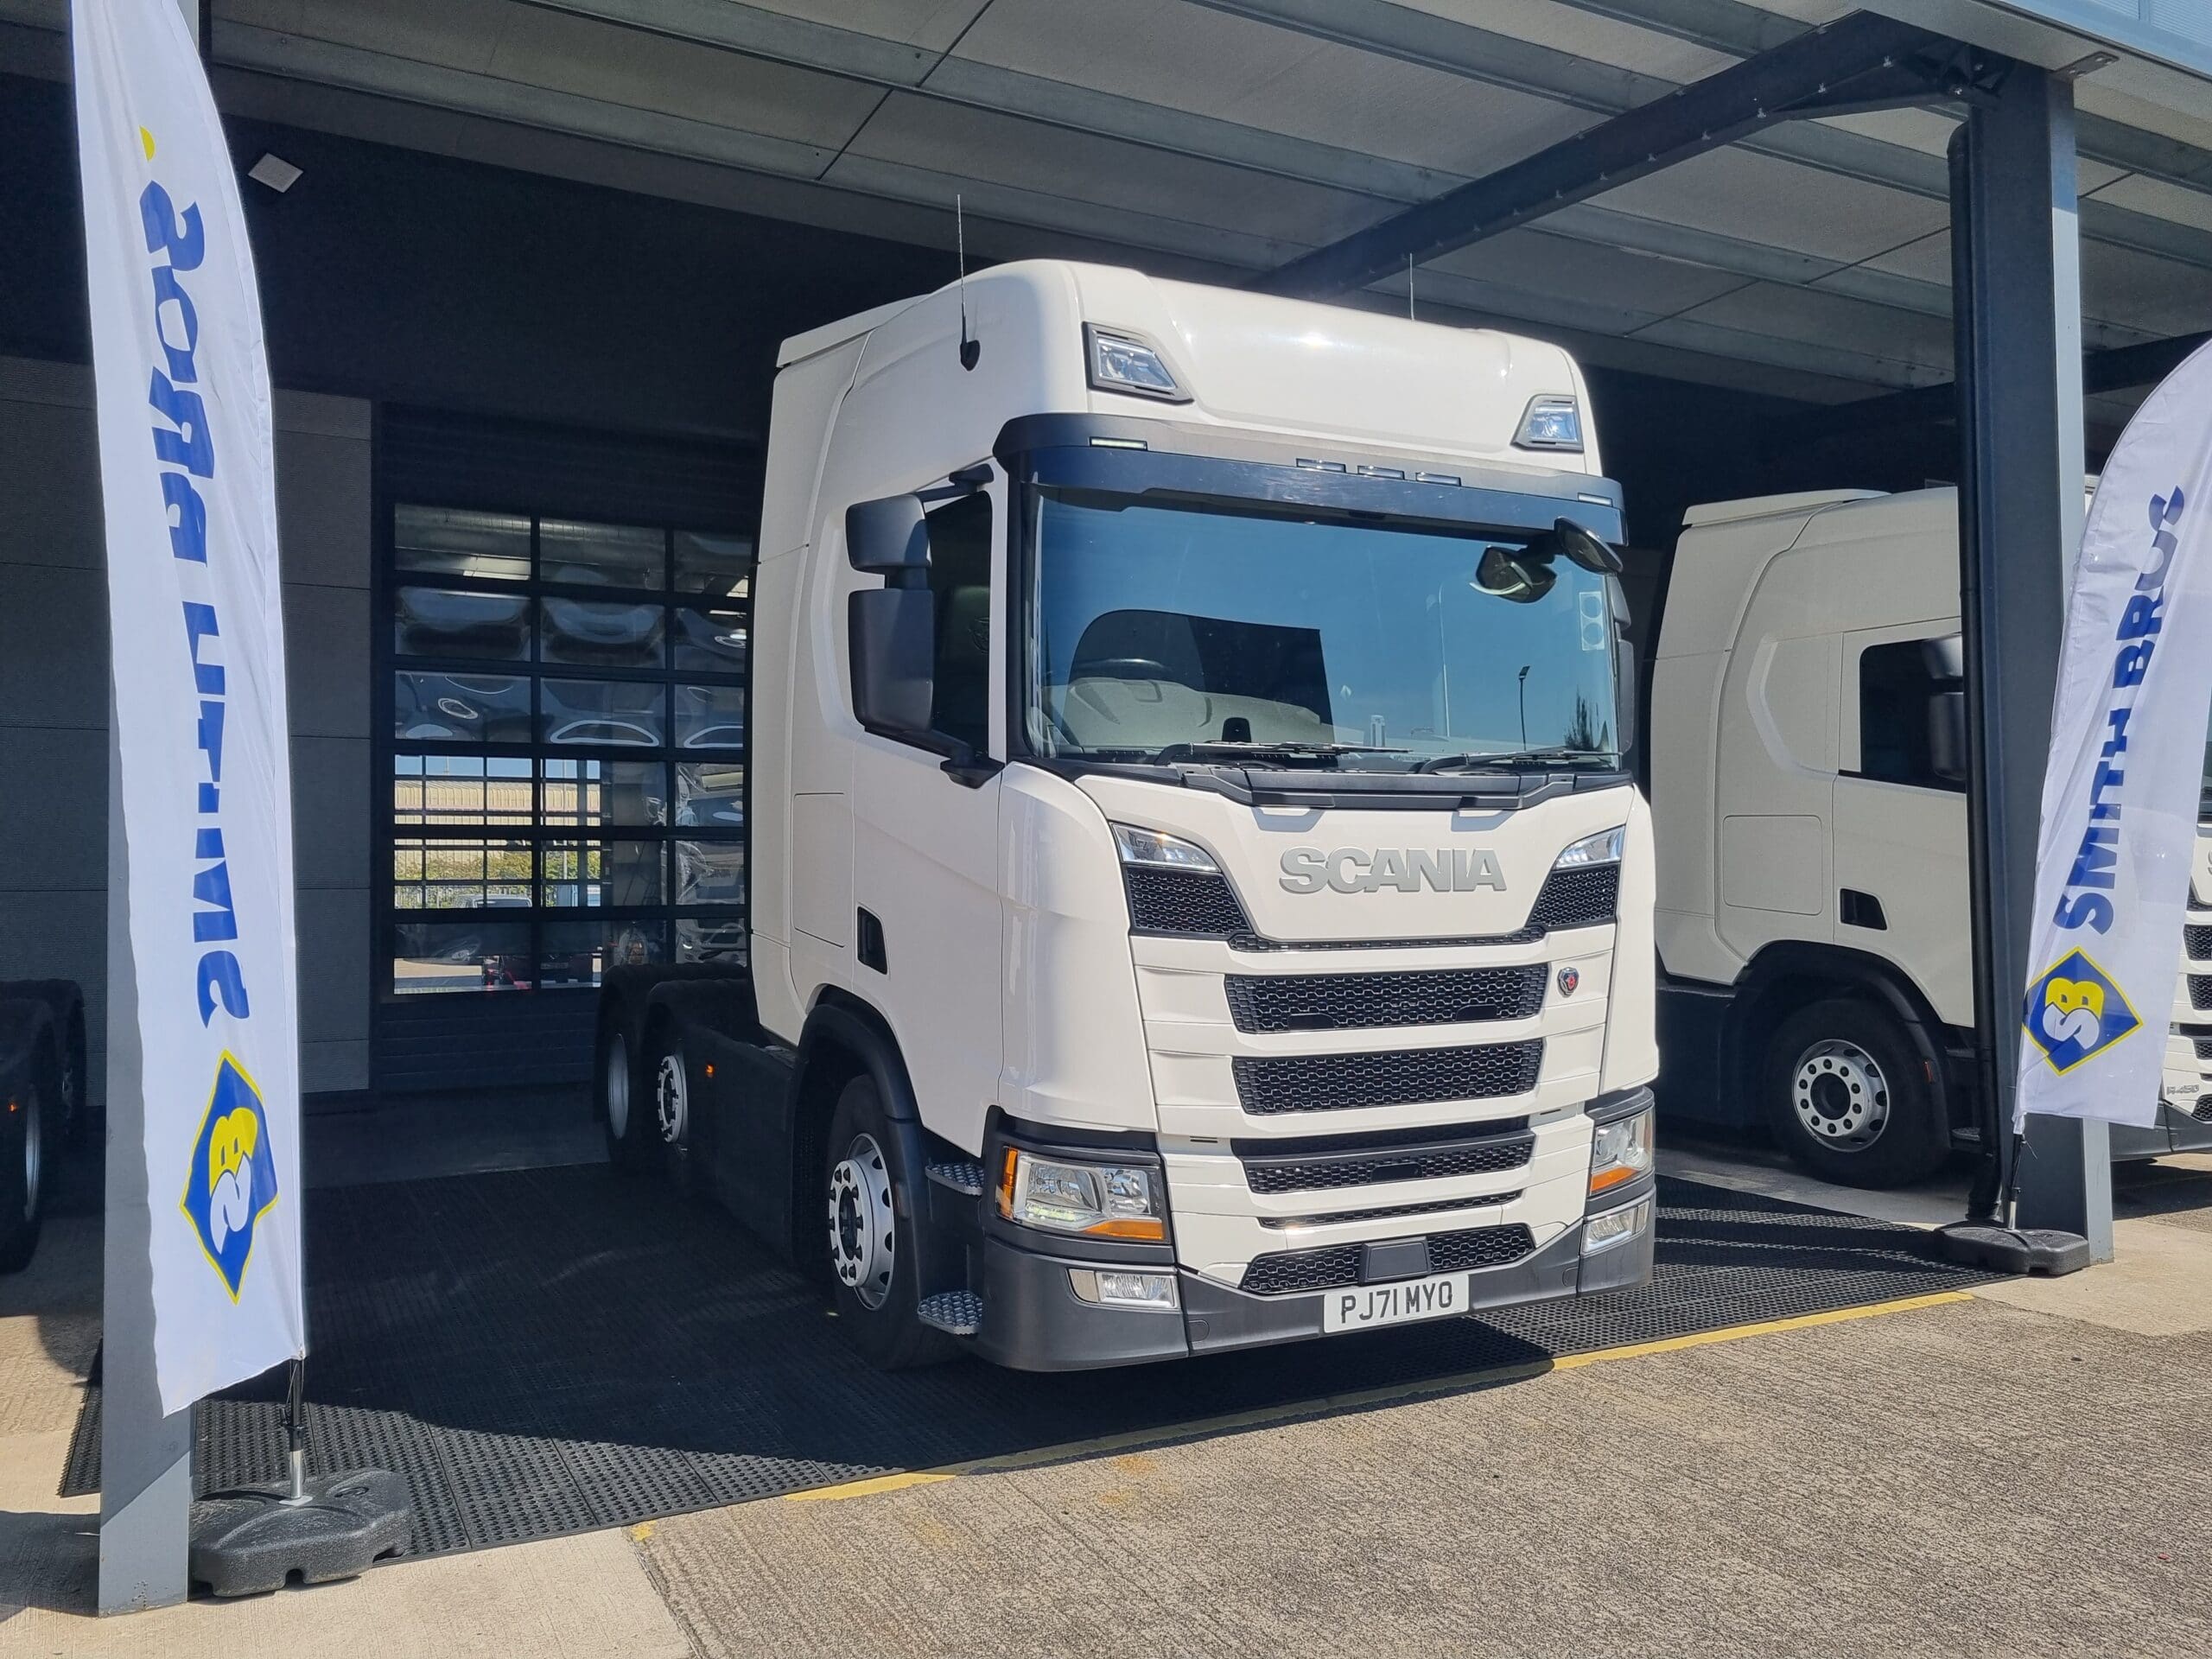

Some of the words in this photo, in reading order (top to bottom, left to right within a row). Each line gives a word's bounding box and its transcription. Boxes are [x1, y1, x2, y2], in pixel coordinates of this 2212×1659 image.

[2053, 708, 2133, 935] SMITH
[1279, 846, 1507, 894] SCANIA
[1340, 1288, 1398, 1324] PJ71
[1405, 1281, 1453, 1314] MYO
